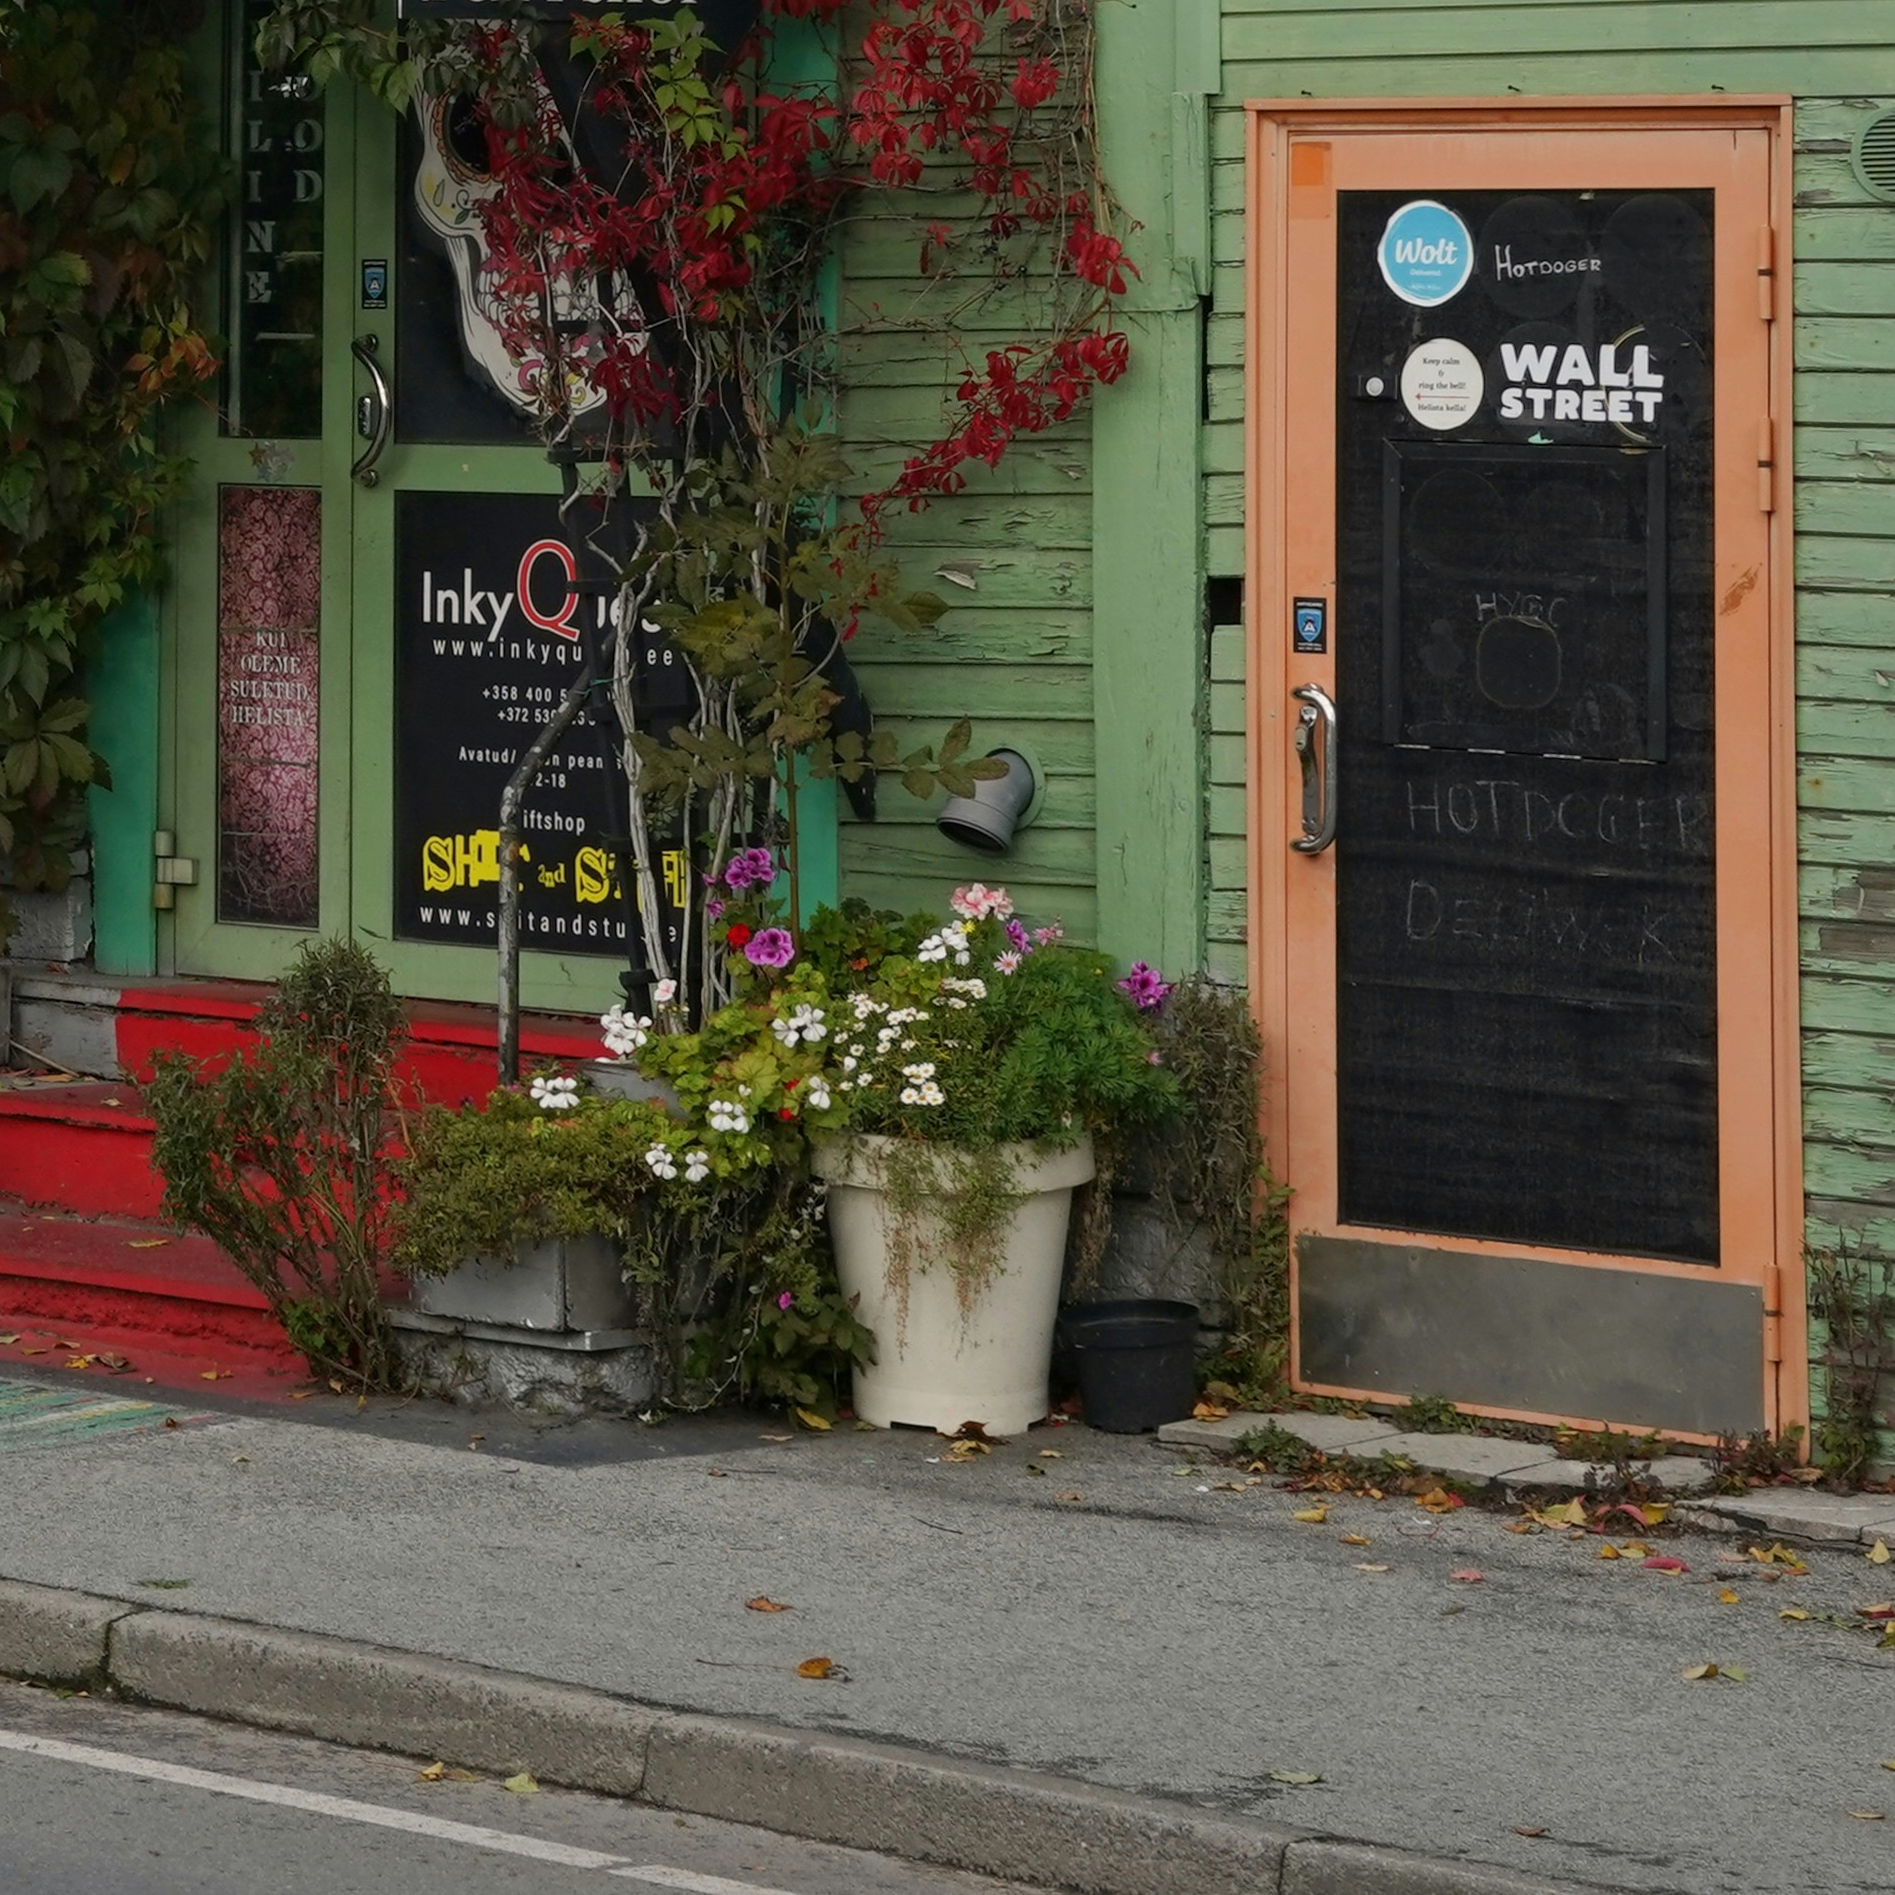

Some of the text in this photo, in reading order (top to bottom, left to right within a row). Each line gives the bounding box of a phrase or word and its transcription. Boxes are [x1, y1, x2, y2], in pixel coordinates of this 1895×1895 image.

[1395, 237, 1458, 265] Wolt
[1500, 342, 1664, 388] WALL
[1500, 387, 1663, 423] STREET
[256, 631, 286, 648] KUI
[240, 654, 301, 675] OLEME
[482, 684, 518, 701] +358
[526, 686, 552, 702] 400
[497, 707, 529, 723] +372
[568, 755, 603, 771] pean
[530, 772, 567, 789] 2-18
[519, 809, 586, 836] iftshop
[537, 863, 567, 888] and
